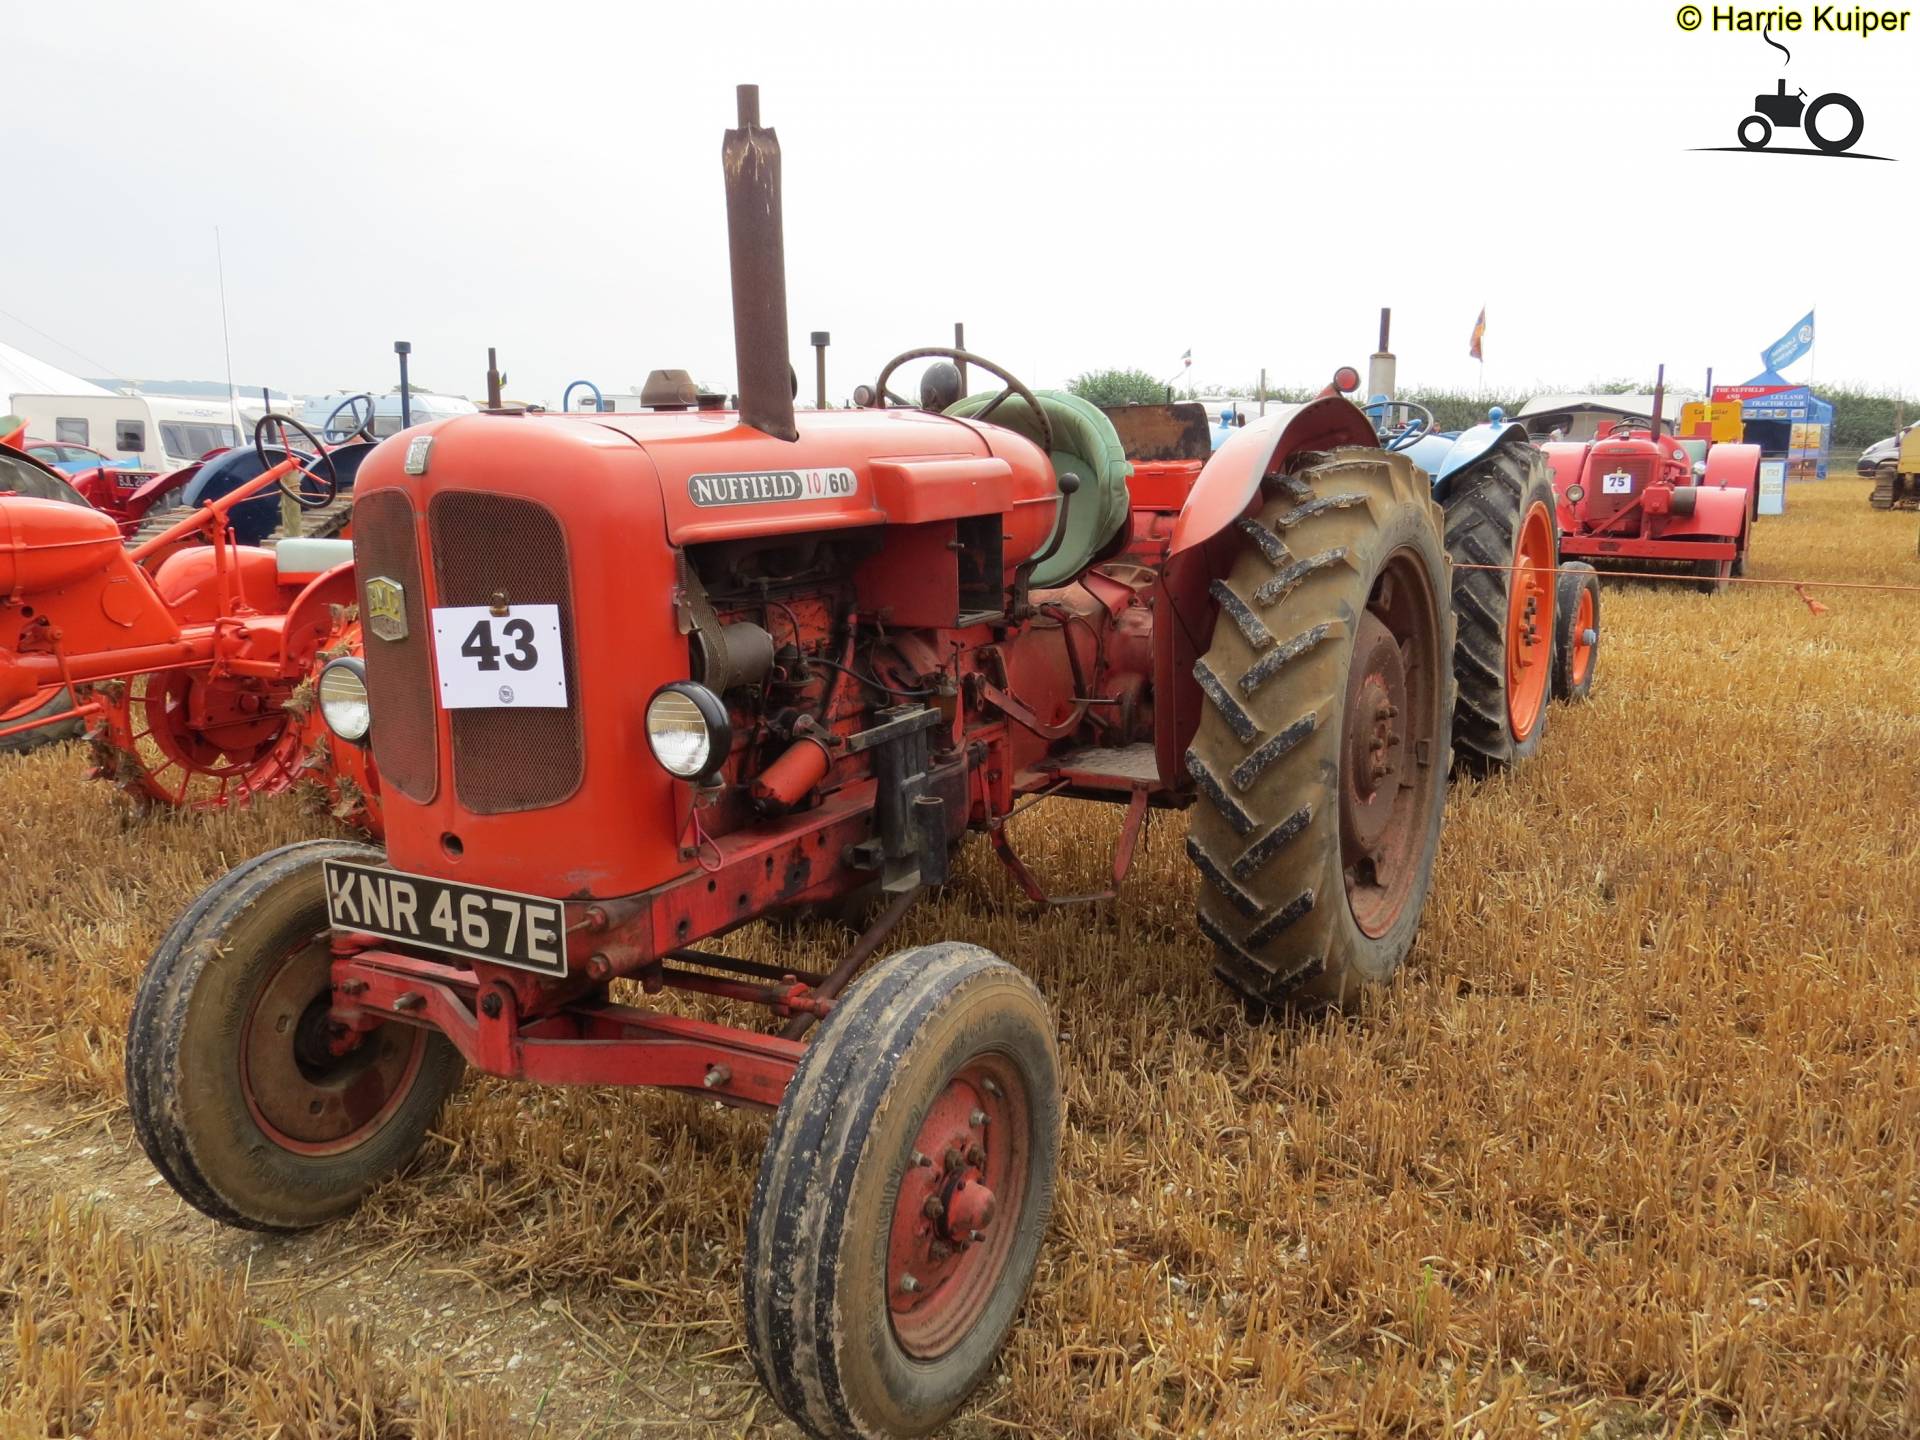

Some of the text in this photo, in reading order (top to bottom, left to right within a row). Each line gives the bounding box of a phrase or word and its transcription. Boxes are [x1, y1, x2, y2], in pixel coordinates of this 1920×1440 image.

[695, 472, 850, 502] NUFFIELD 10/60
[1609, 477, 1625, 487] 75
[461, 618, 539, 672] 43
[330, 869, 558, 965] KNR 467E
